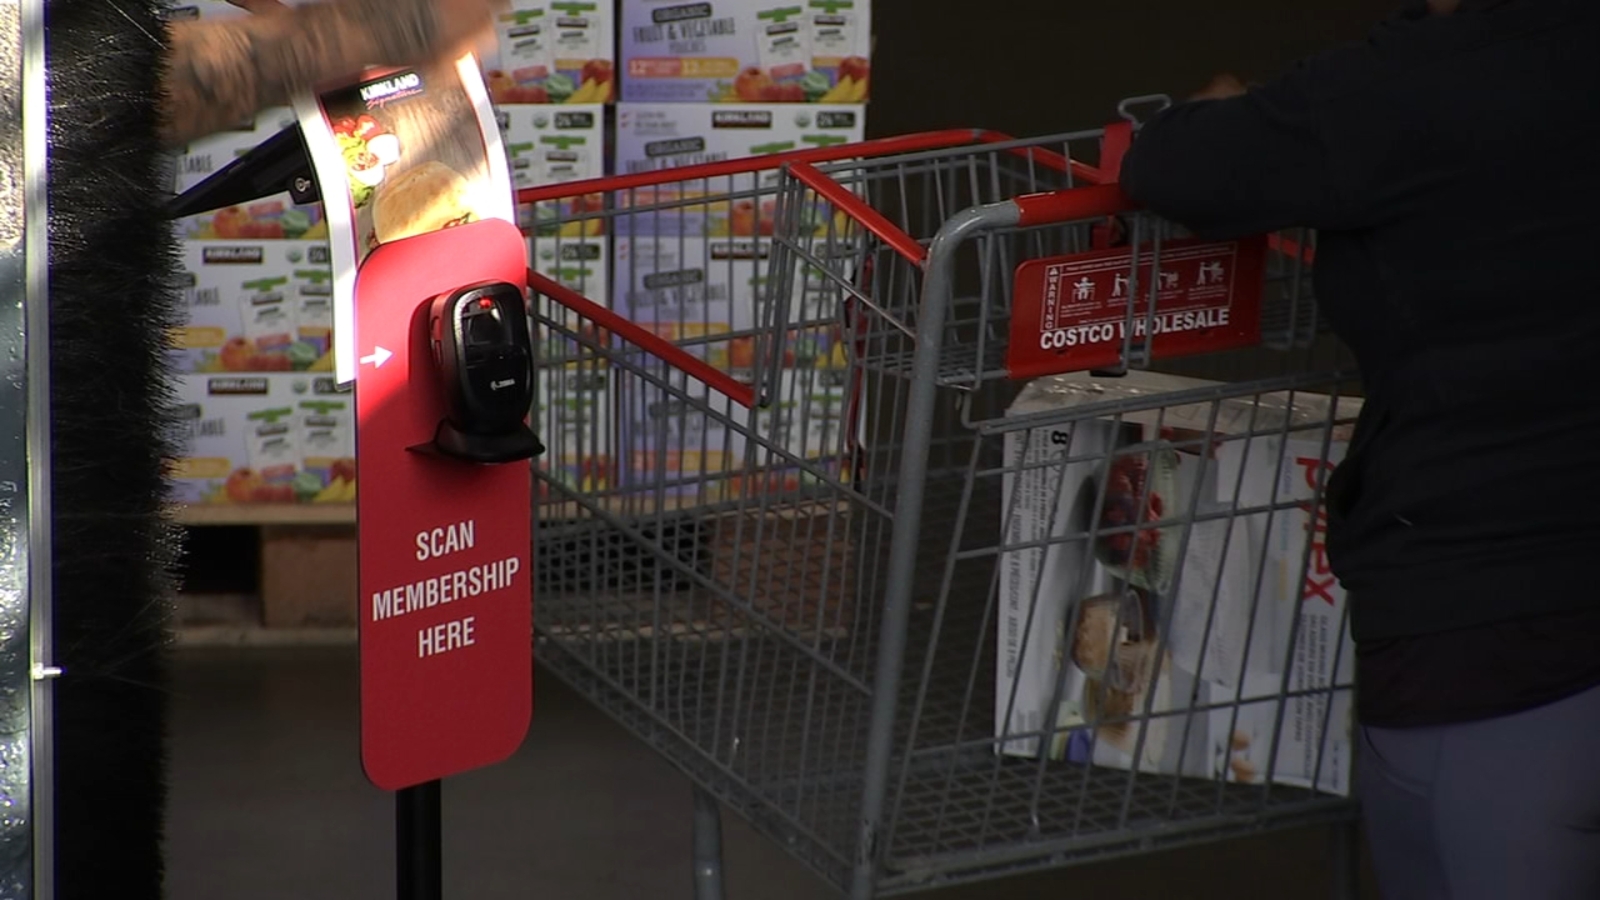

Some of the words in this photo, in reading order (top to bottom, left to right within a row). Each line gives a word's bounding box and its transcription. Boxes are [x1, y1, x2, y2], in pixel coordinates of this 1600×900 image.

[360, 73, 420, 101] KIRKLAND
[713, 112, 770, 122] KIRKLAND
[1045, 275, 1059, 331] WARNING
[1040, 323, 1114, 349] COSTCO
[1051, 431, 1069, 446] 8
[415, 519, 475, 561] SCAN
[372, 557, 520, 622] MEMBERSHIP
[418, 616, 475, 659] HERE
